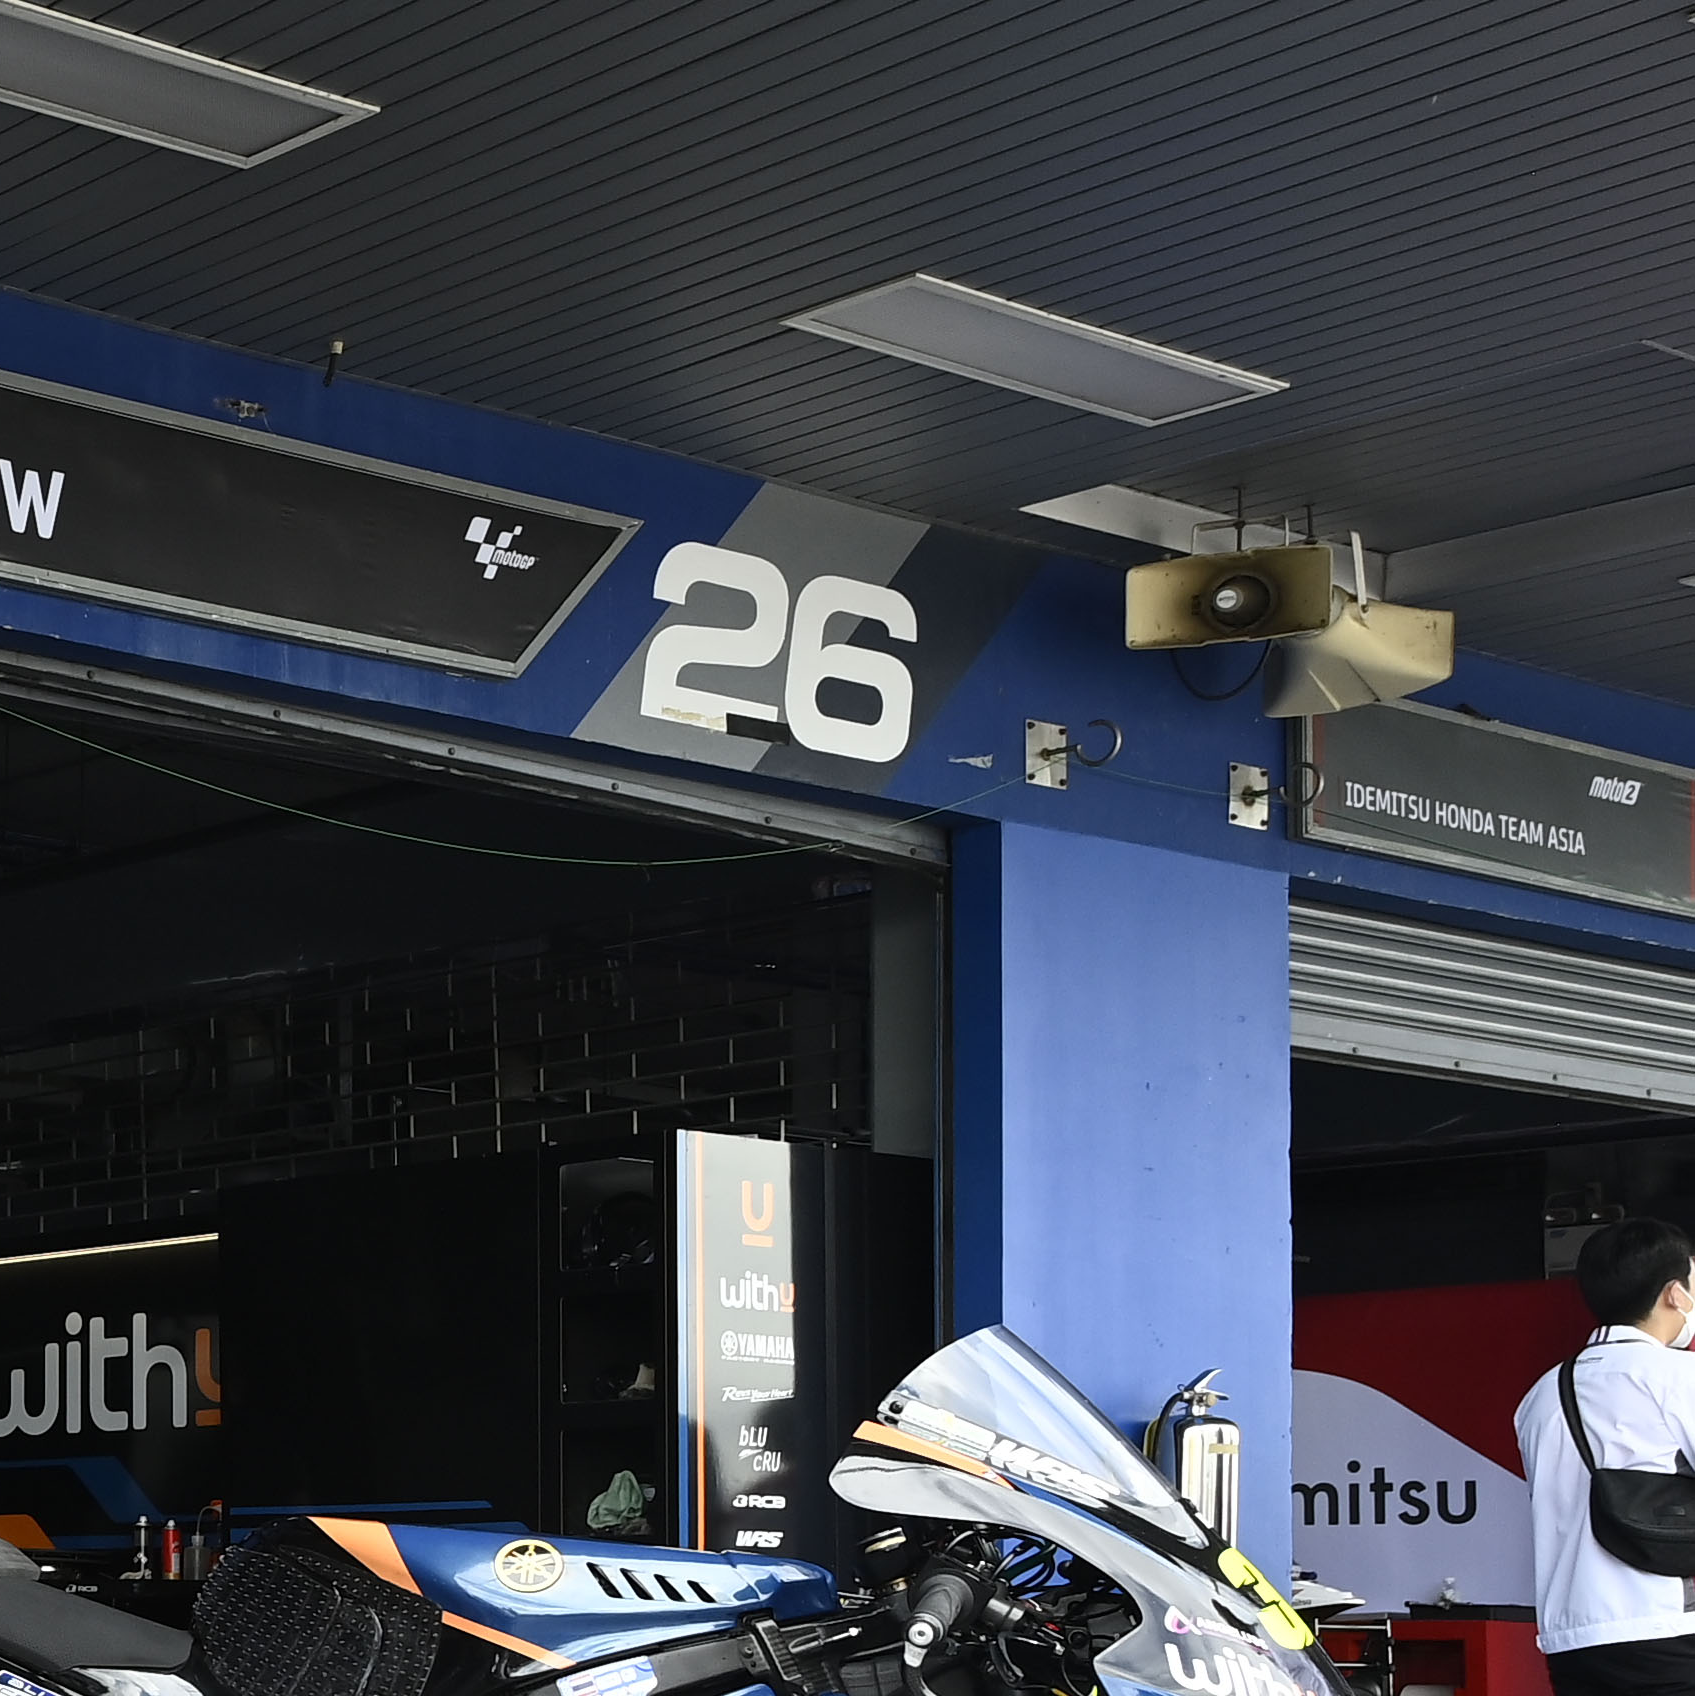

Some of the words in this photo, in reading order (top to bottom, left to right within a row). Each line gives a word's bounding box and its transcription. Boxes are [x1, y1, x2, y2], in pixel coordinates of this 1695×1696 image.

[640, 541, 918, 762] 26
[1345, 781, 1430, 822] IDEMITSU
[1435, 801, 1496, 837] HONDA
[1499, 814, 1544, 847] TEAM
[1547, 827, 1587, 856] ASIA
[737, 1333, 795, 1360] YAMAHA
[735, 1530, 784, 1548] WRS
